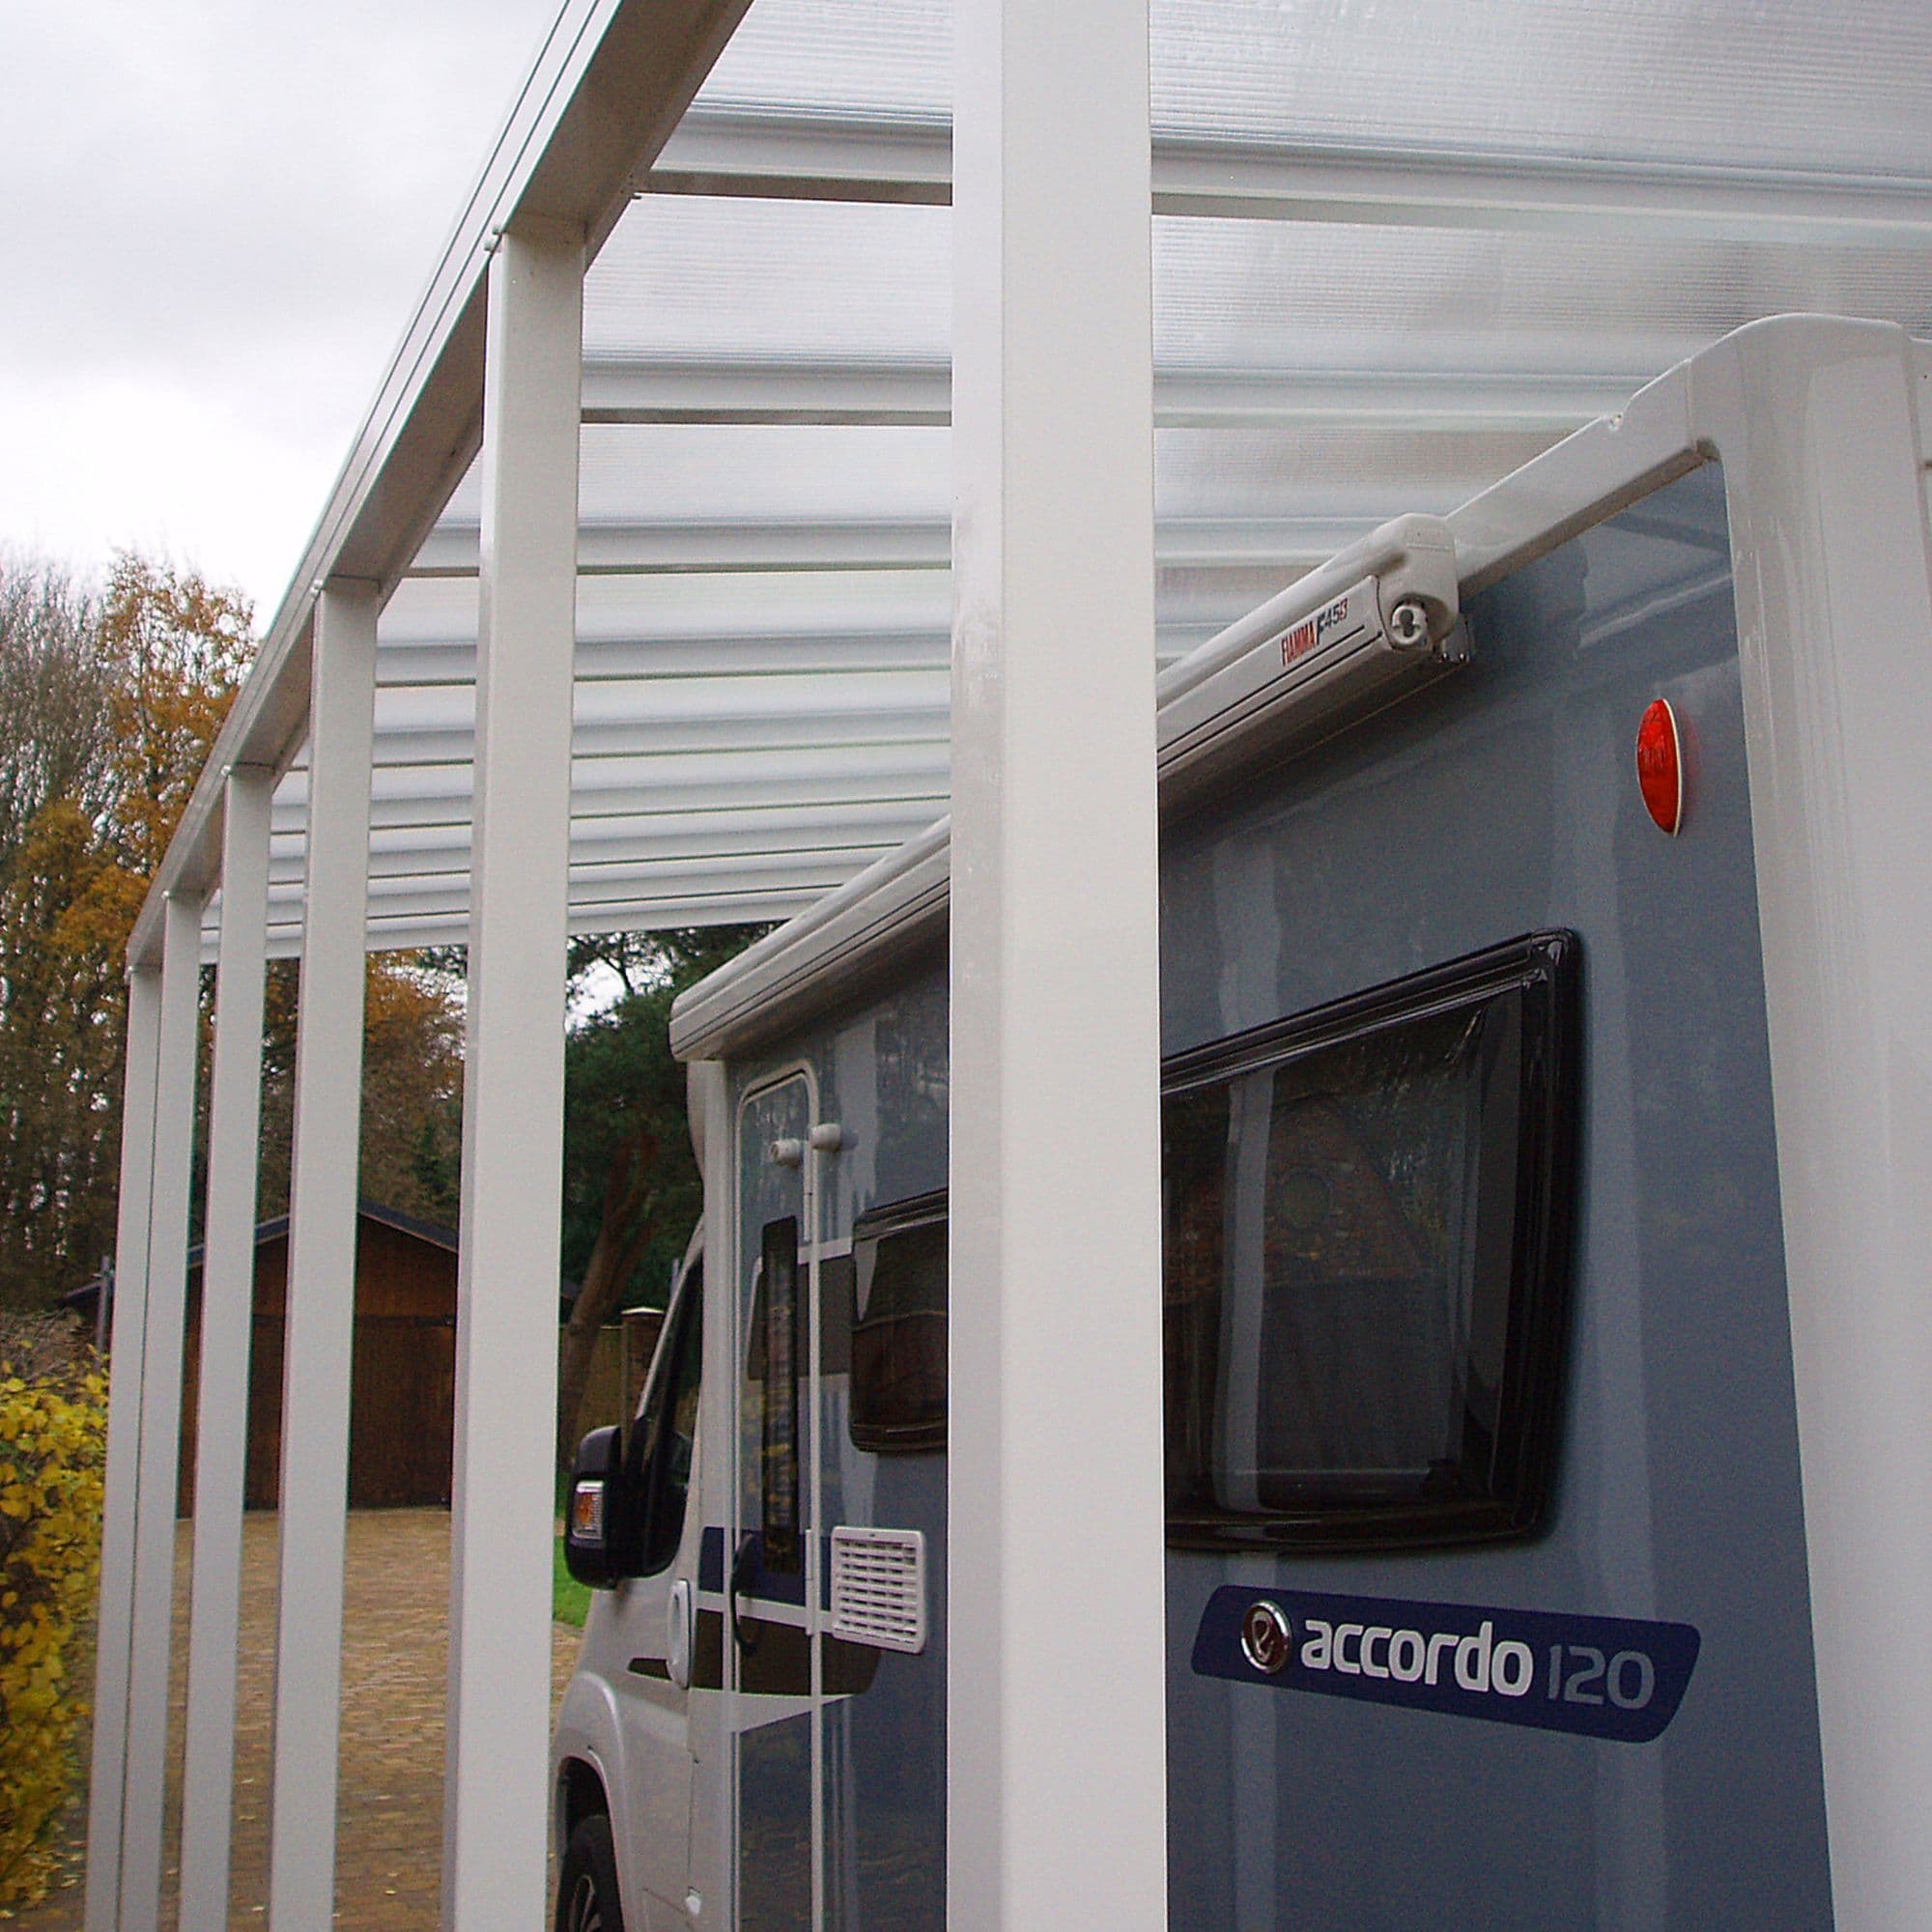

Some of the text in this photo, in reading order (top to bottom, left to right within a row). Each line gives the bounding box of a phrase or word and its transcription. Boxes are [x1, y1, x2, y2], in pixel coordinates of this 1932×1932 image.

[1281, 620, 1316, 668] FIAMMA
[1300, 1620, 1656, 1710] accordo 120
